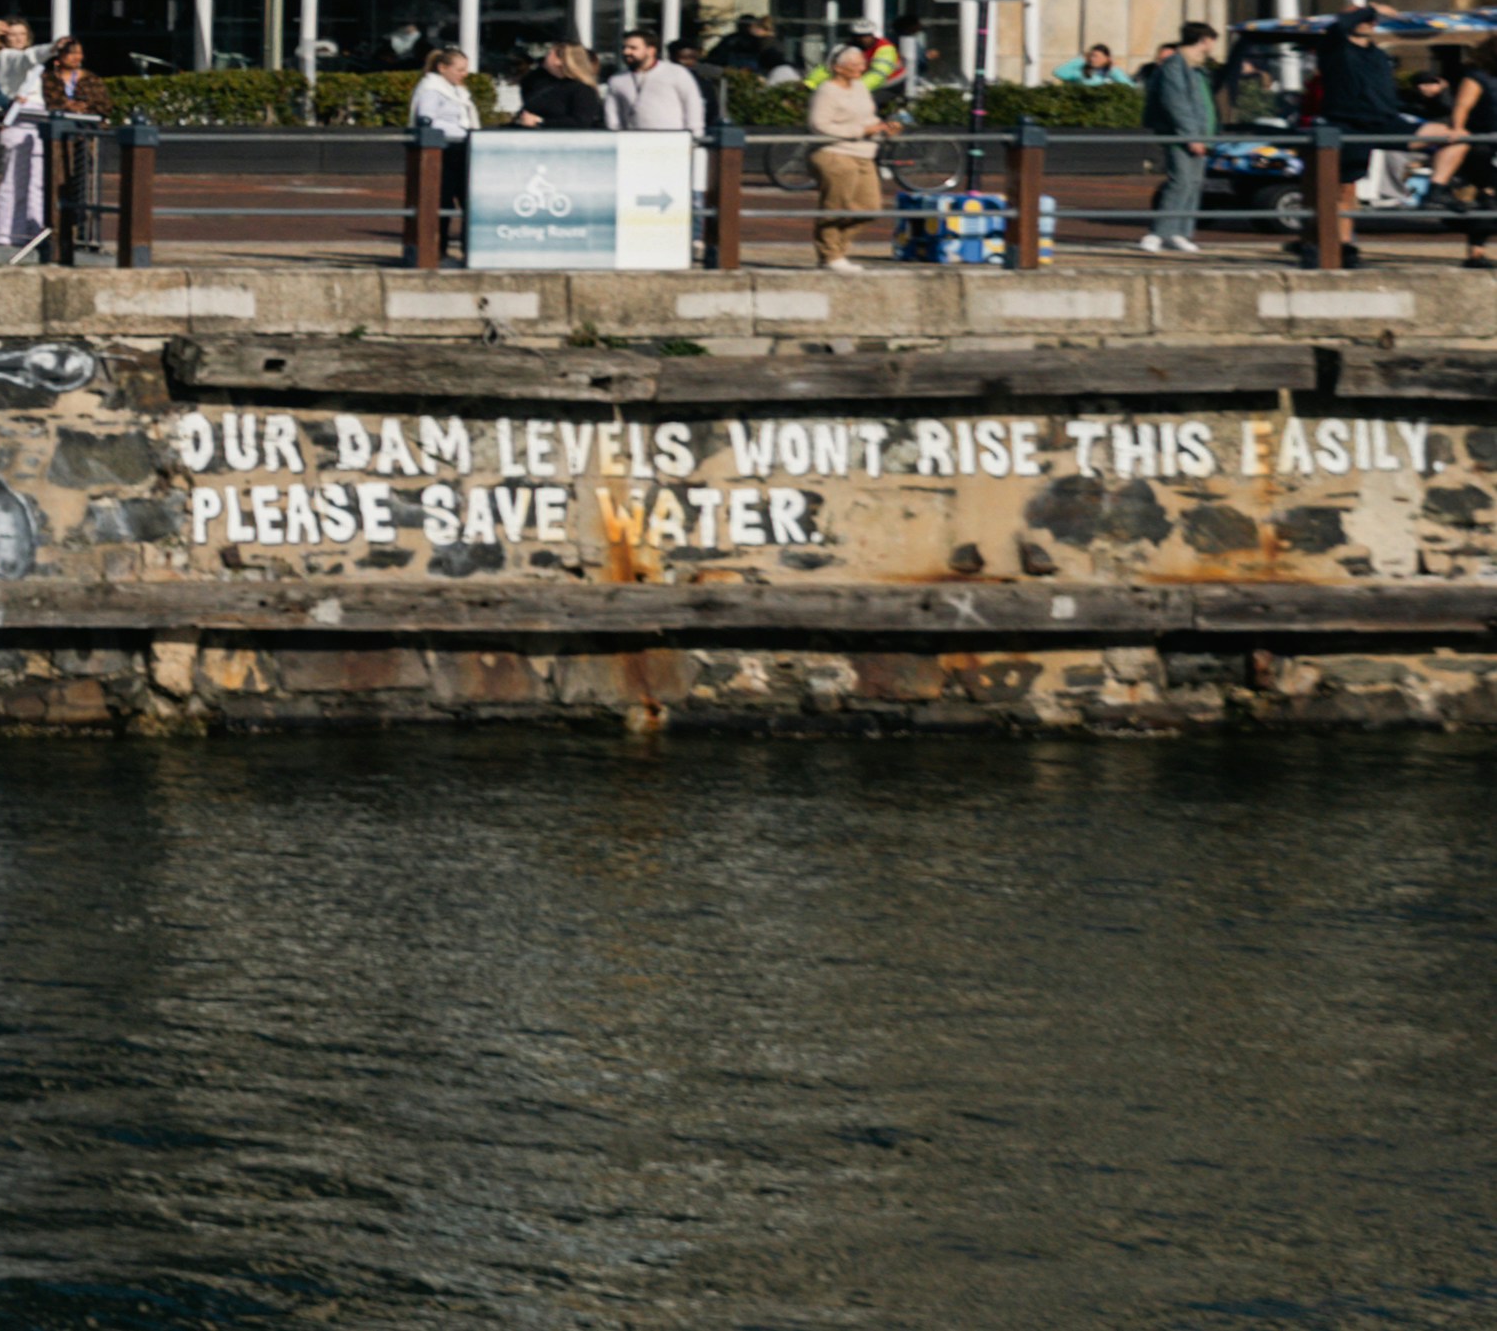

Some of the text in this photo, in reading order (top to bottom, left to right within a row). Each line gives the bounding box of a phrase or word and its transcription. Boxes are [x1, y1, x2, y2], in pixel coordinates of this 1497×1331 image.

[176, 412, 305, 474] OUR
[334, 415, 470, 476] DAM
[496, 417, 699, 478] LEVELS
[916, 418, 1041, 478] RISE
[1065, 419, 1217, 480] THIS
[190, 482, 826, 547] PLEASE SAVE WATER.
